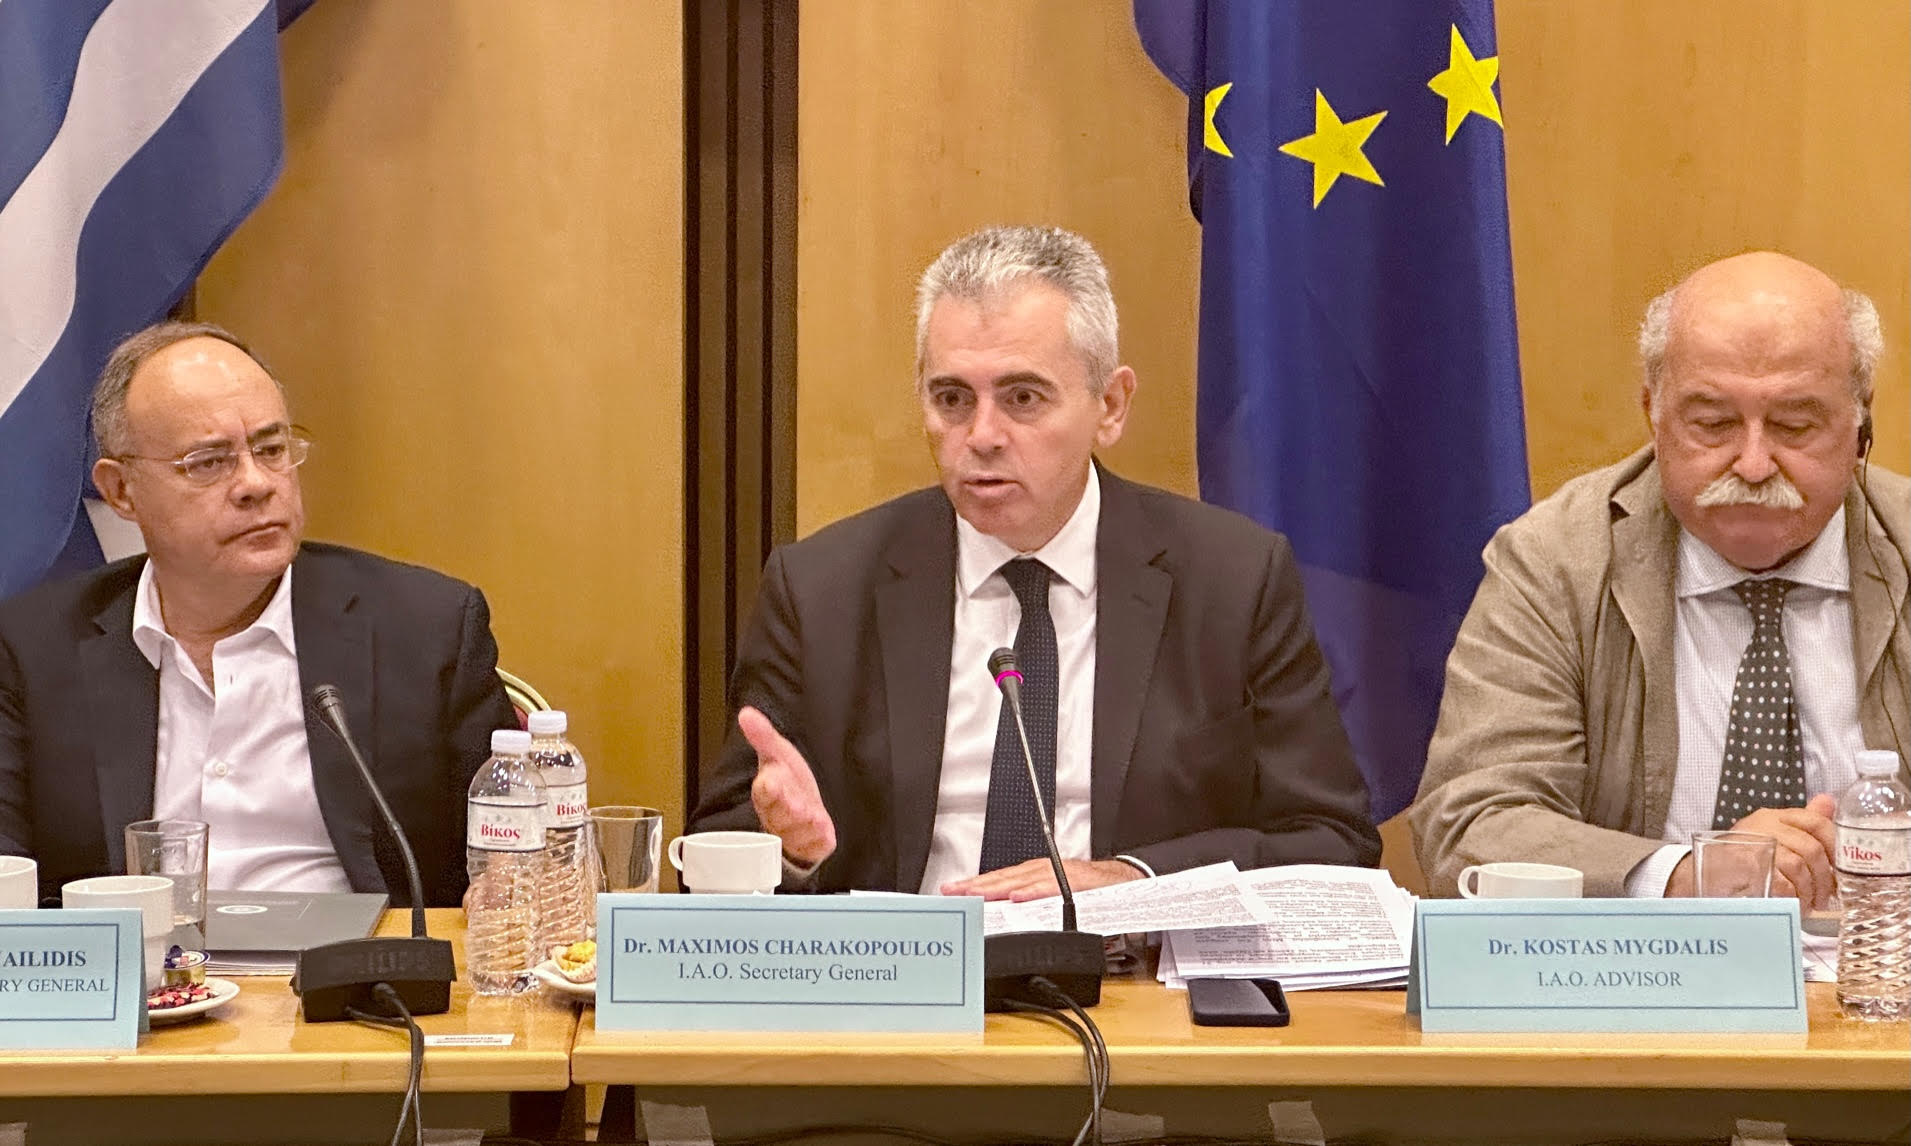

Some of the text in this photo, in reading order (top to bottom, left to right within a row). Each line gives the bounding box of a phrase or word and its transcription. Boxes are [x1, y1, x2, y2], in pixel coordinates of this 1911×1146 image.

[481, 824, 521, 840] Βίκος
[623, 938, 954, 957] Dr. MAXIMOS CHARAKOPOULOS
[1488, 938, 1729, 955] Dr. KOSTAS MYGDALIS
[0, 950, 87, 967] AILIDIS
[678, 962, 898, 985] I.A.O. Secretary General
[1537, 971, 1683, 987] I.A.O. ADVISOR
[27, 978, 110, 992] GENERAL
